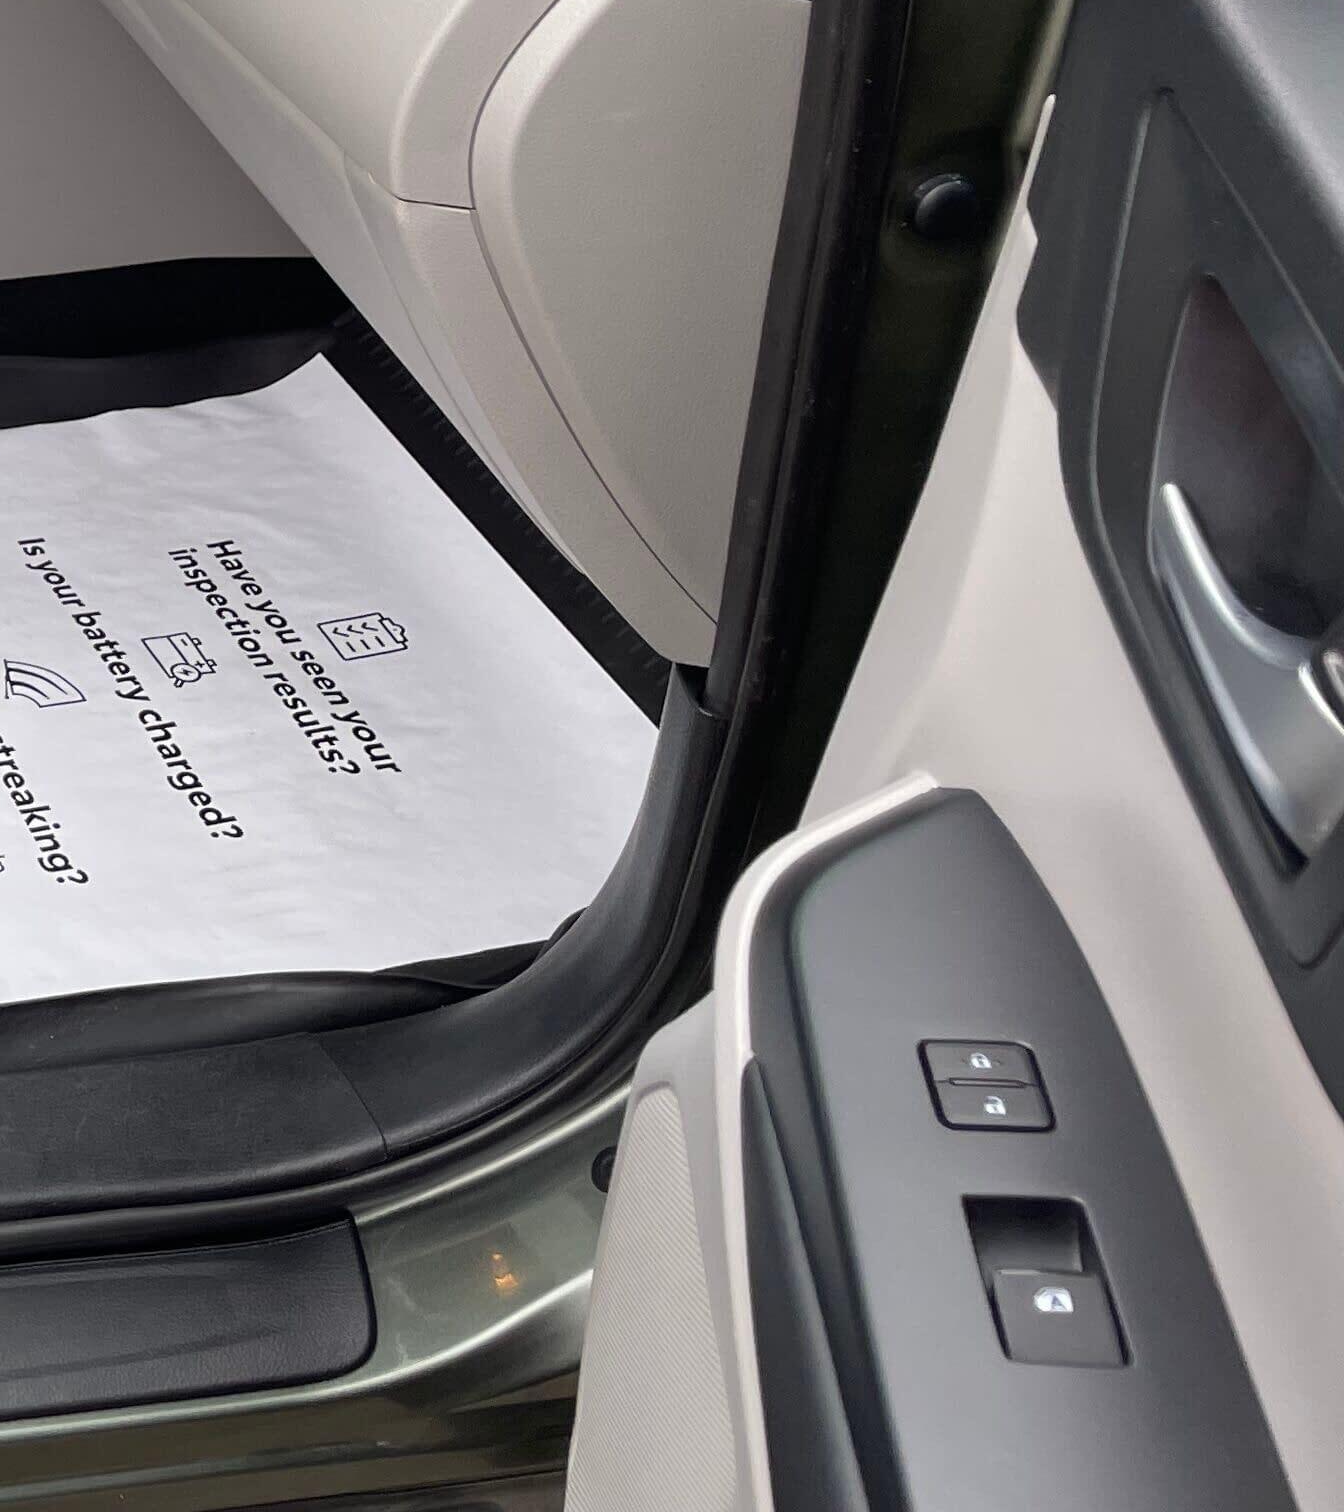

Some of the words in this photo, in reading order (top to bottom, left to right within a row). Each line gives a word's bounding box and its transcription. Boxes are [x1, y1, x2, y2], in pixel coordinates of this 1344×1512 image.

[18, 538, 46, 556] Is
[25, 560, 85, 607] your
[72, 611, 151, 702] battery
[169, 548, 273, 667] inspection
[264, 673, 361, 774] results?
[207, 540, 262, 596] Have
[245, 600, 302, 644] you
[290, 650, 349, 705] seen
[330, 711, 401, 772] your
[139, 709, 244, 839] charged?
